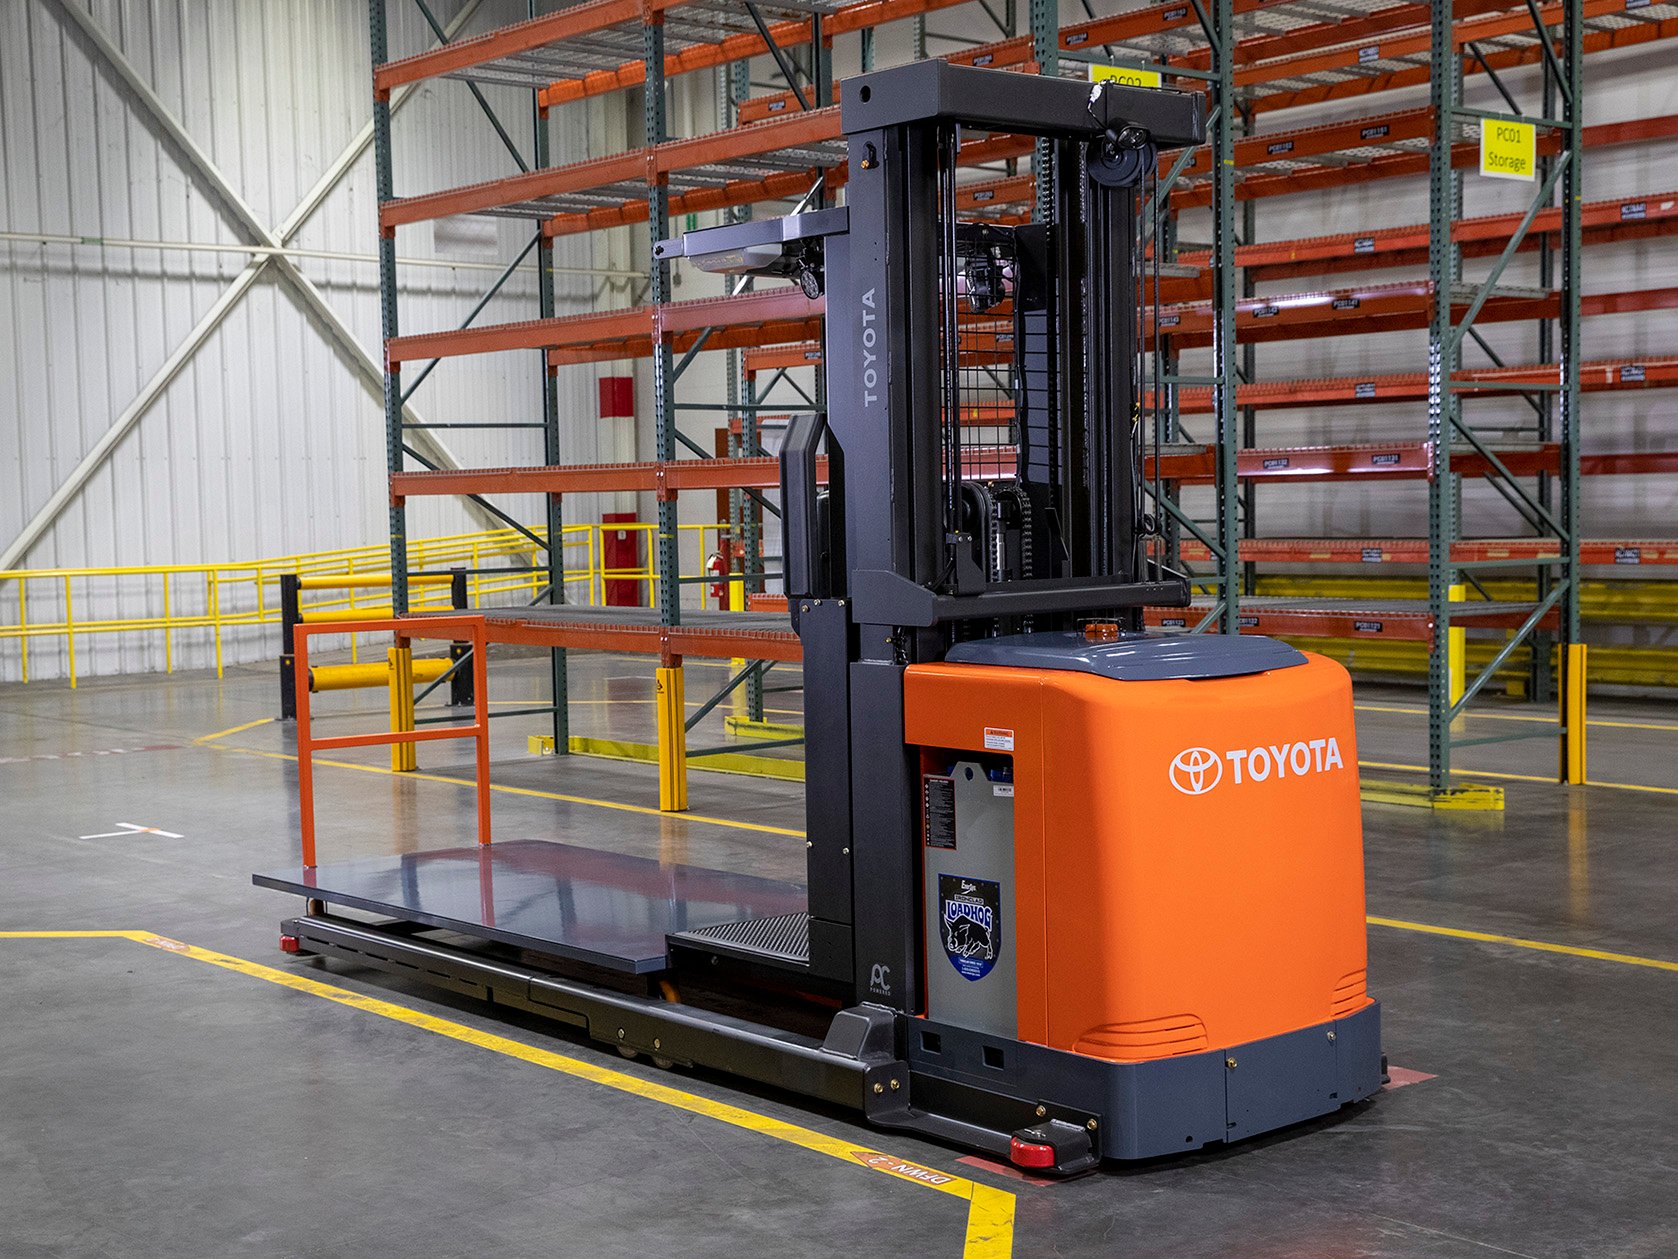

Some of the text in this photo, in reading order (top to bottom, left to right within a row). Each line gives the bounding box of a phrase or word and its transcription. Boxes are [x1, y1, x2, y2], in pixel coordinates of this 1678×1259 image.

[1496, 127, 1521, 143] PC01
[1488, 151, 1526, 172] Storage
[861, 287, 878, 408] TOYOTA
[1226, 736, 1344, 784] TOYOTA
[945, 900, 993, 931] LOADHOG
[891, 1164, 952, 1184] DFWN
